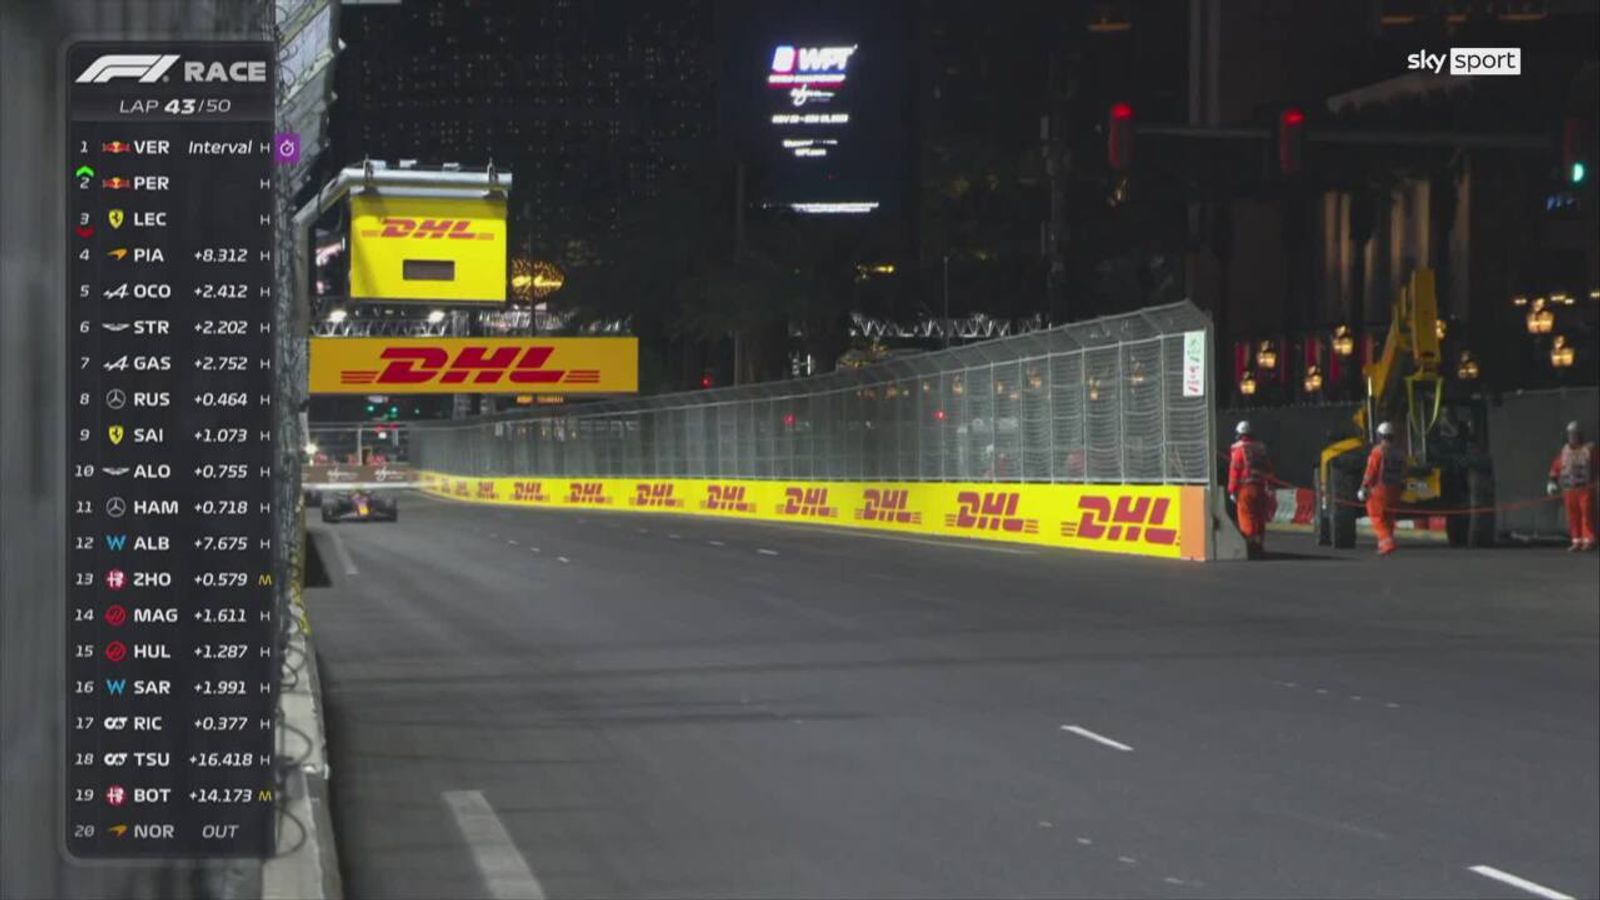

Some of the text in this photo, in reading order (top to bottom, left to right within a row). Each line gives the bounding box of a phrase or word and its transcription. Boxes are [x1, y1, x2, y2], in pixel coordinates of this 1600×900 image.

[380, 218, 476, 240] DHL
[374, 347, 563, 383] DHL
[515, 483, 542, 500] DHL
[570, 484, 604, 503] DHL
[637, 485, 675, 506] DHL
[707, 486, 748, 511] DHL
[785, 488, 830, 516] DHL
[863, 489, 914, 523] DHL
[957, 492, 1024, 532] DHL
[1077, 496, 1178, 545] DHL
